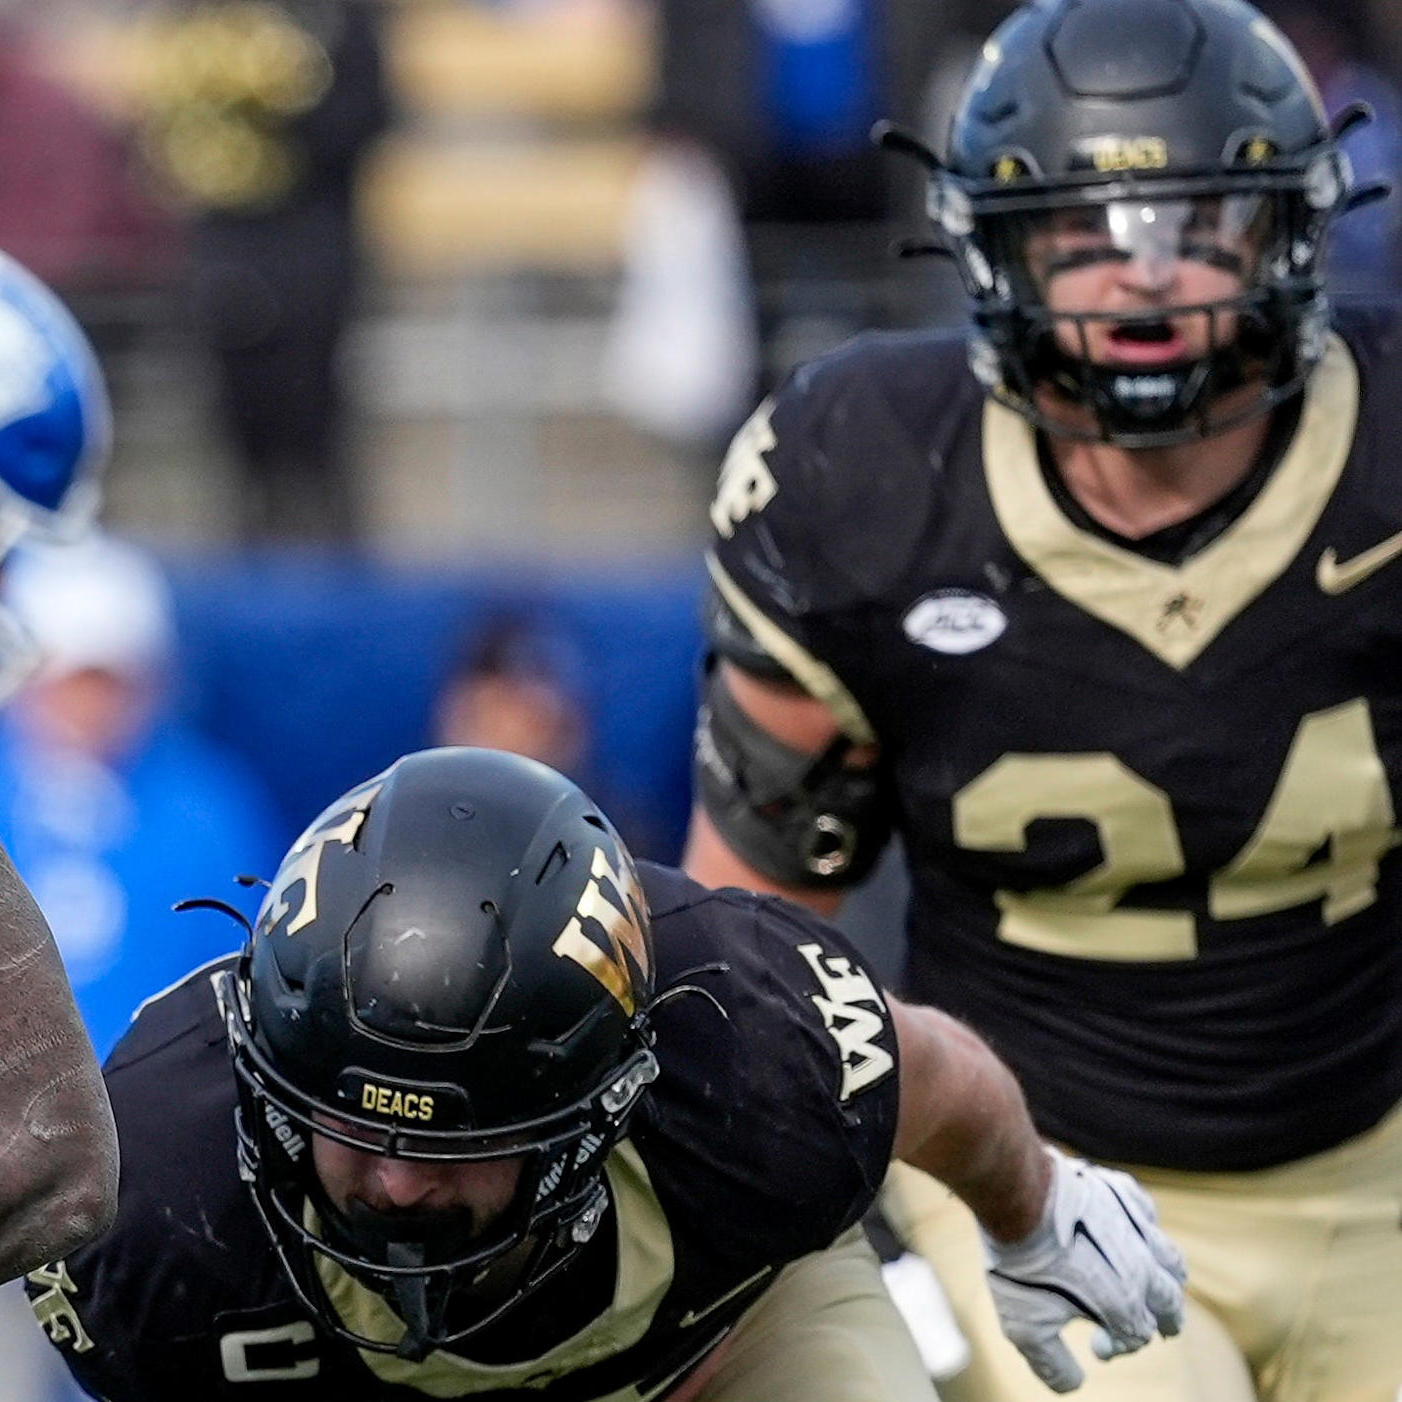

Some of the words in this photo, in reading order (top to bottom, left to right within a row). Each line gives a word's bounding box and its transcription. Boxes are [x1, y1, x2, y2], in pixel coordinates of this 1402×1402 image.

[951, 696, 1402, 963] 24
[361, 1082, 435, 1122] DEACS
[220, 1320, 321, 1384] C
